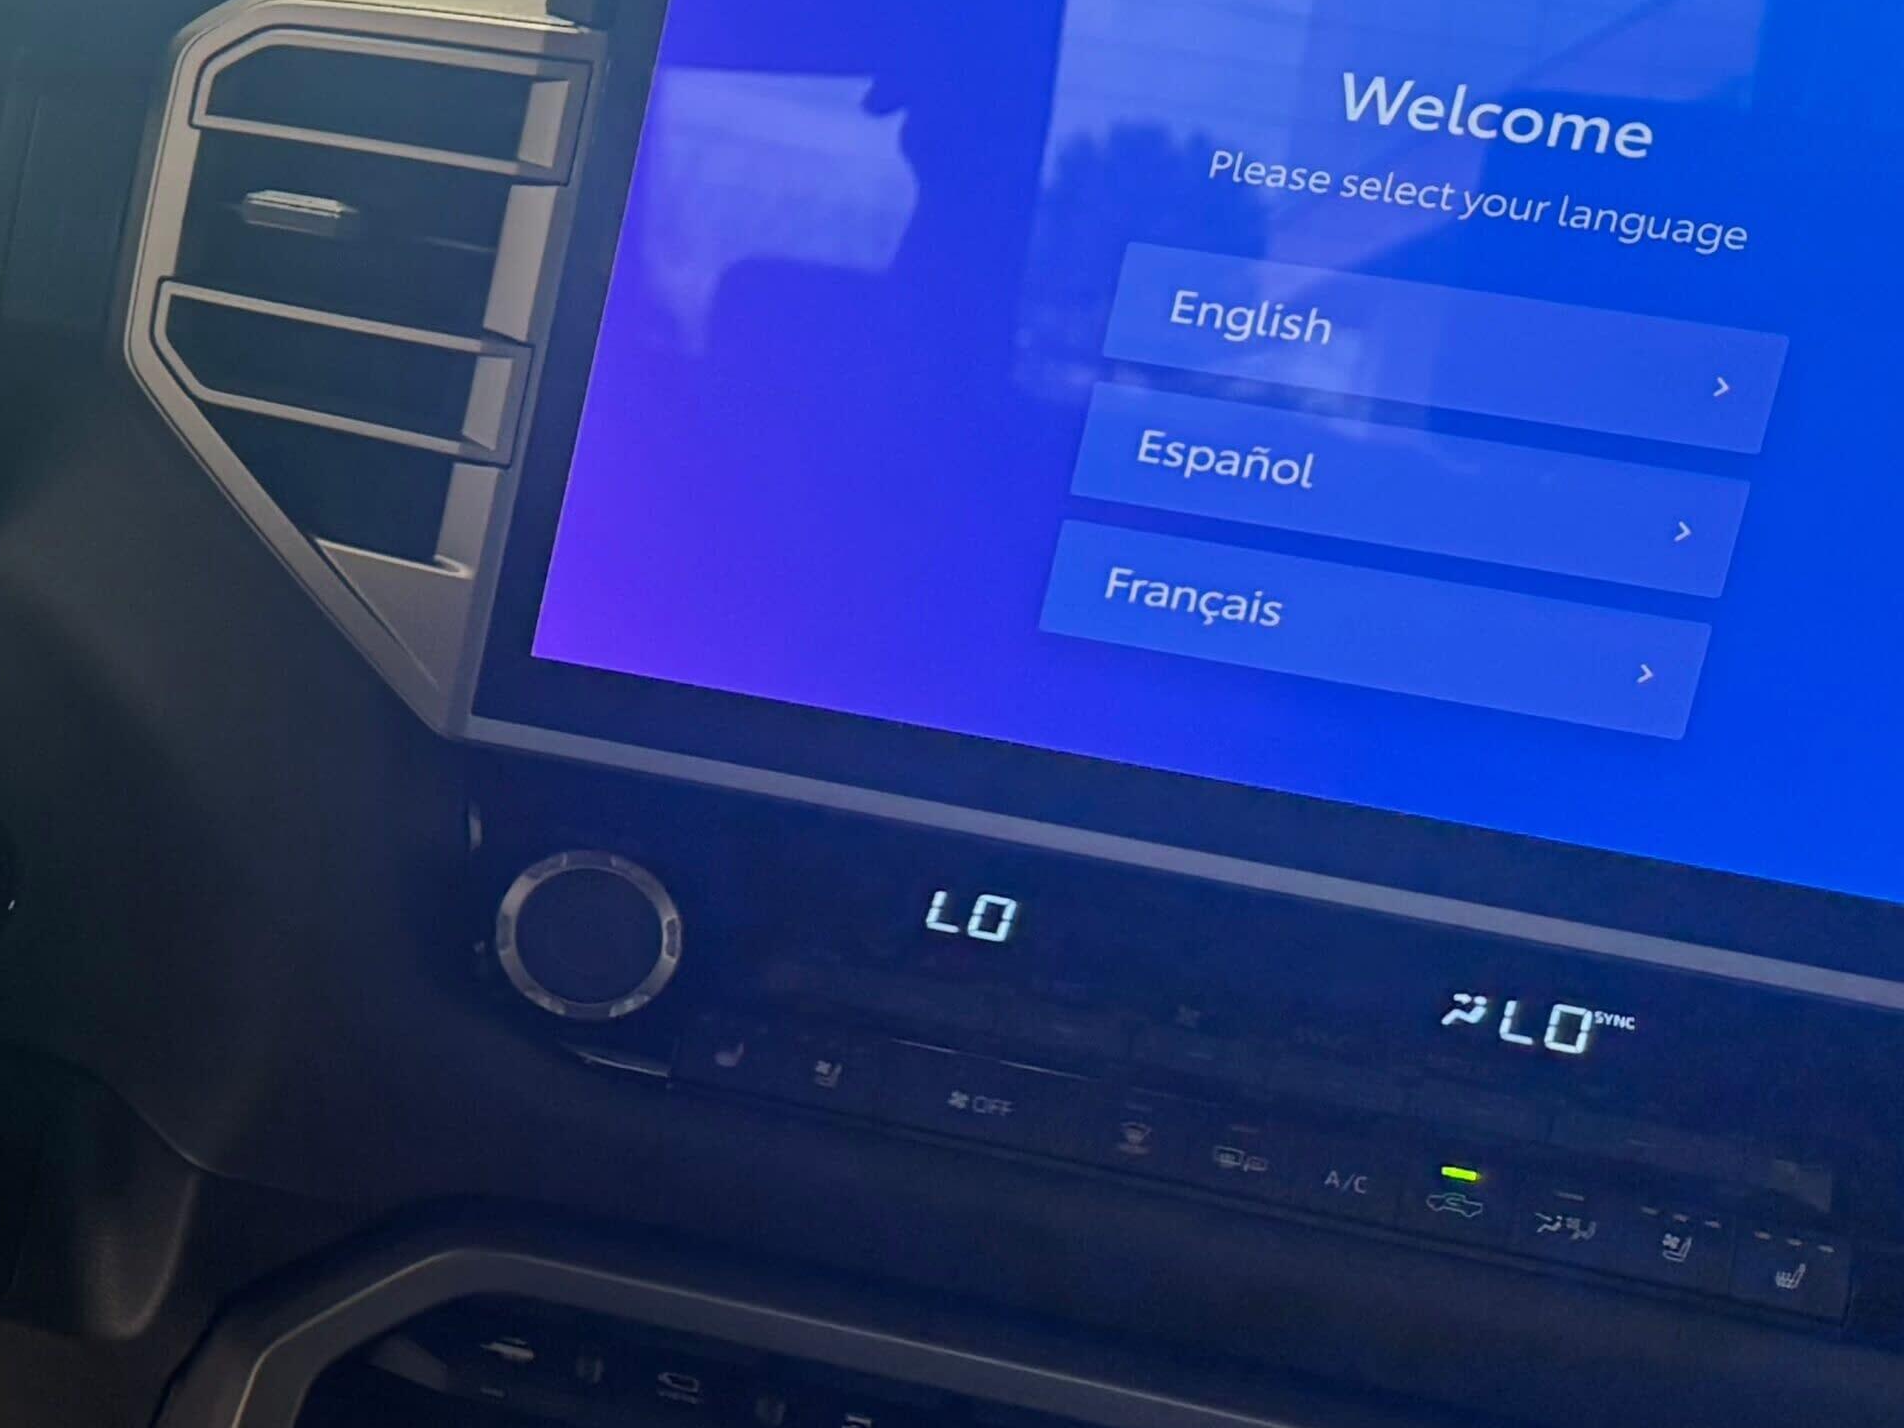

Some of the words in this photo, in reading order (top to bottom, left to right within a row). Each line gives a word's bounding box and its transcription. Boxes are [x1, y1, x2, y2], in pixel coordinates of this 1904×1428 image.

[1340, 69, 1654, 160] Welcome
[1207, 149, 1331, 195] Please
[1340, 170, 1454, 213] select
[1457, 187, 1551, 226] your
[1557, 193, 1749, 256] language
[1168, 289, 1333, 347] English
[1136, 428, 1315, 490] Español
[1103, 566, 1284, 628] Français
[925, 890, 1018, 943] LO
[1498, 998, 1593, 1055] LO
[1593, 1009, 1636, 1031] SYNC
[1323, 1169, 1369, 1196] A/C
